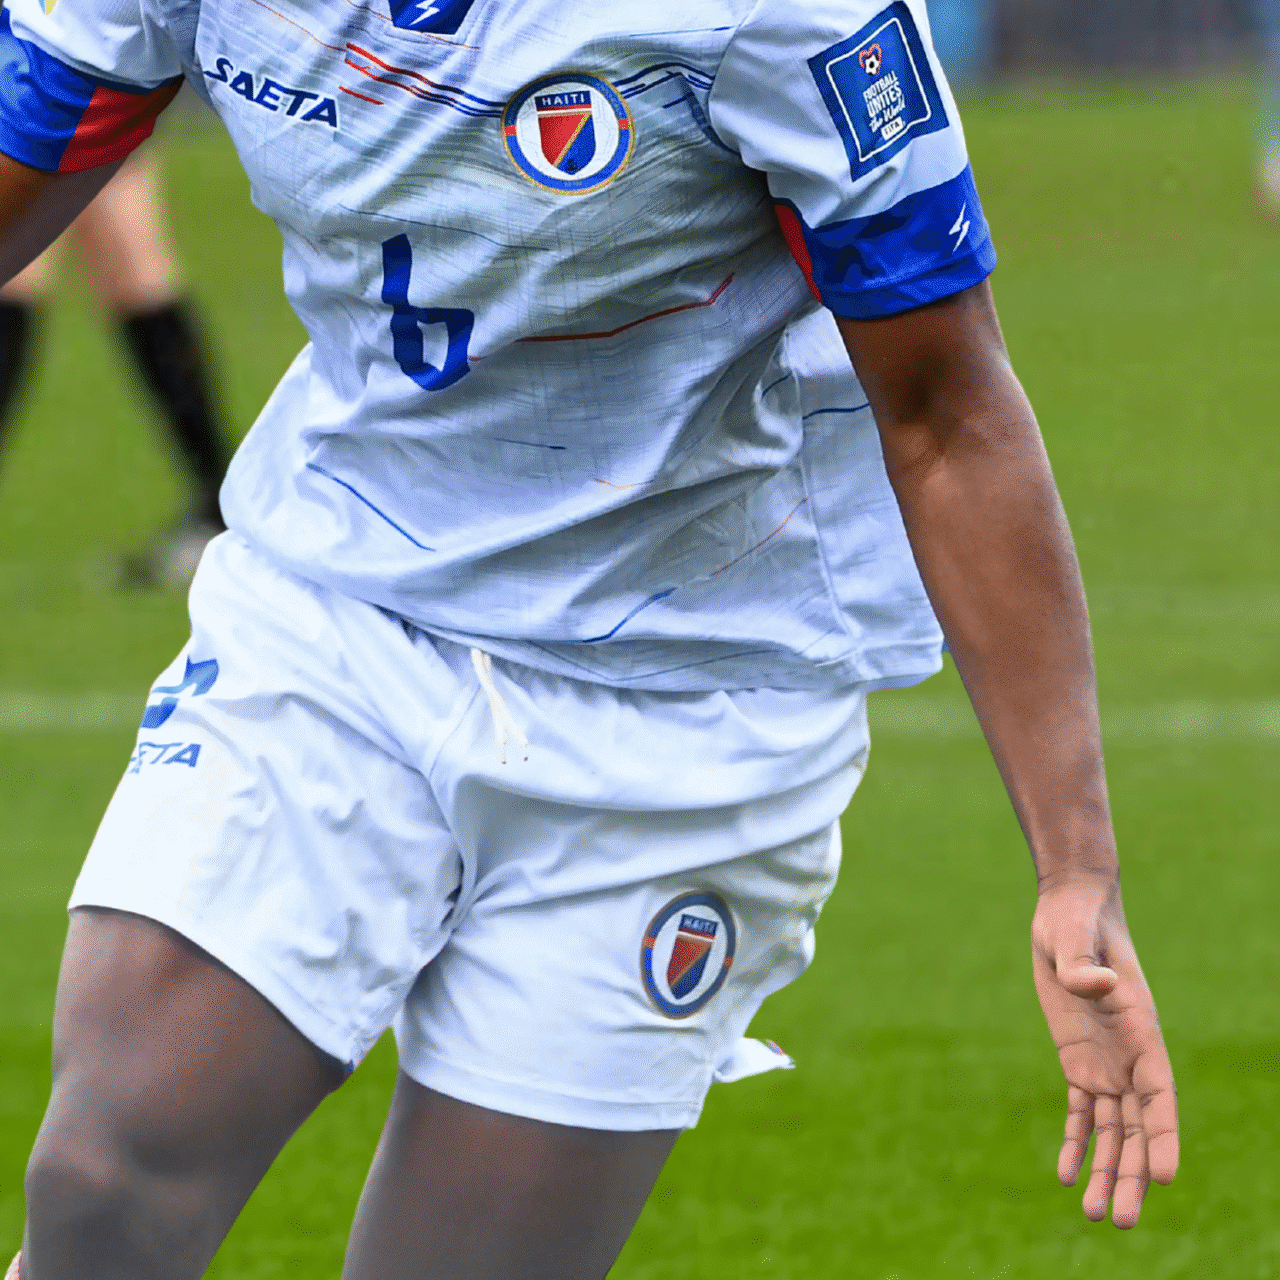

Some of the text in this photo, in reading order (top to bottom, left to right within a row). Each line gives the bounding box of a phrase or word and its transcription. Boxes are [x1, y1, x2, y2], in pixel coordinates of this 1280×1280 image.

[204, 57, 340, 127] SAETA
[541, 93, 585, 106] HAITI
[863, 70, 898, 104] FOOTBALL
[867, 81, 902, 118] UNITES
[883, 93, 906, 122] World
[883, 121, 900, 135] FIFA
[381, 233, 475, 391] 6
